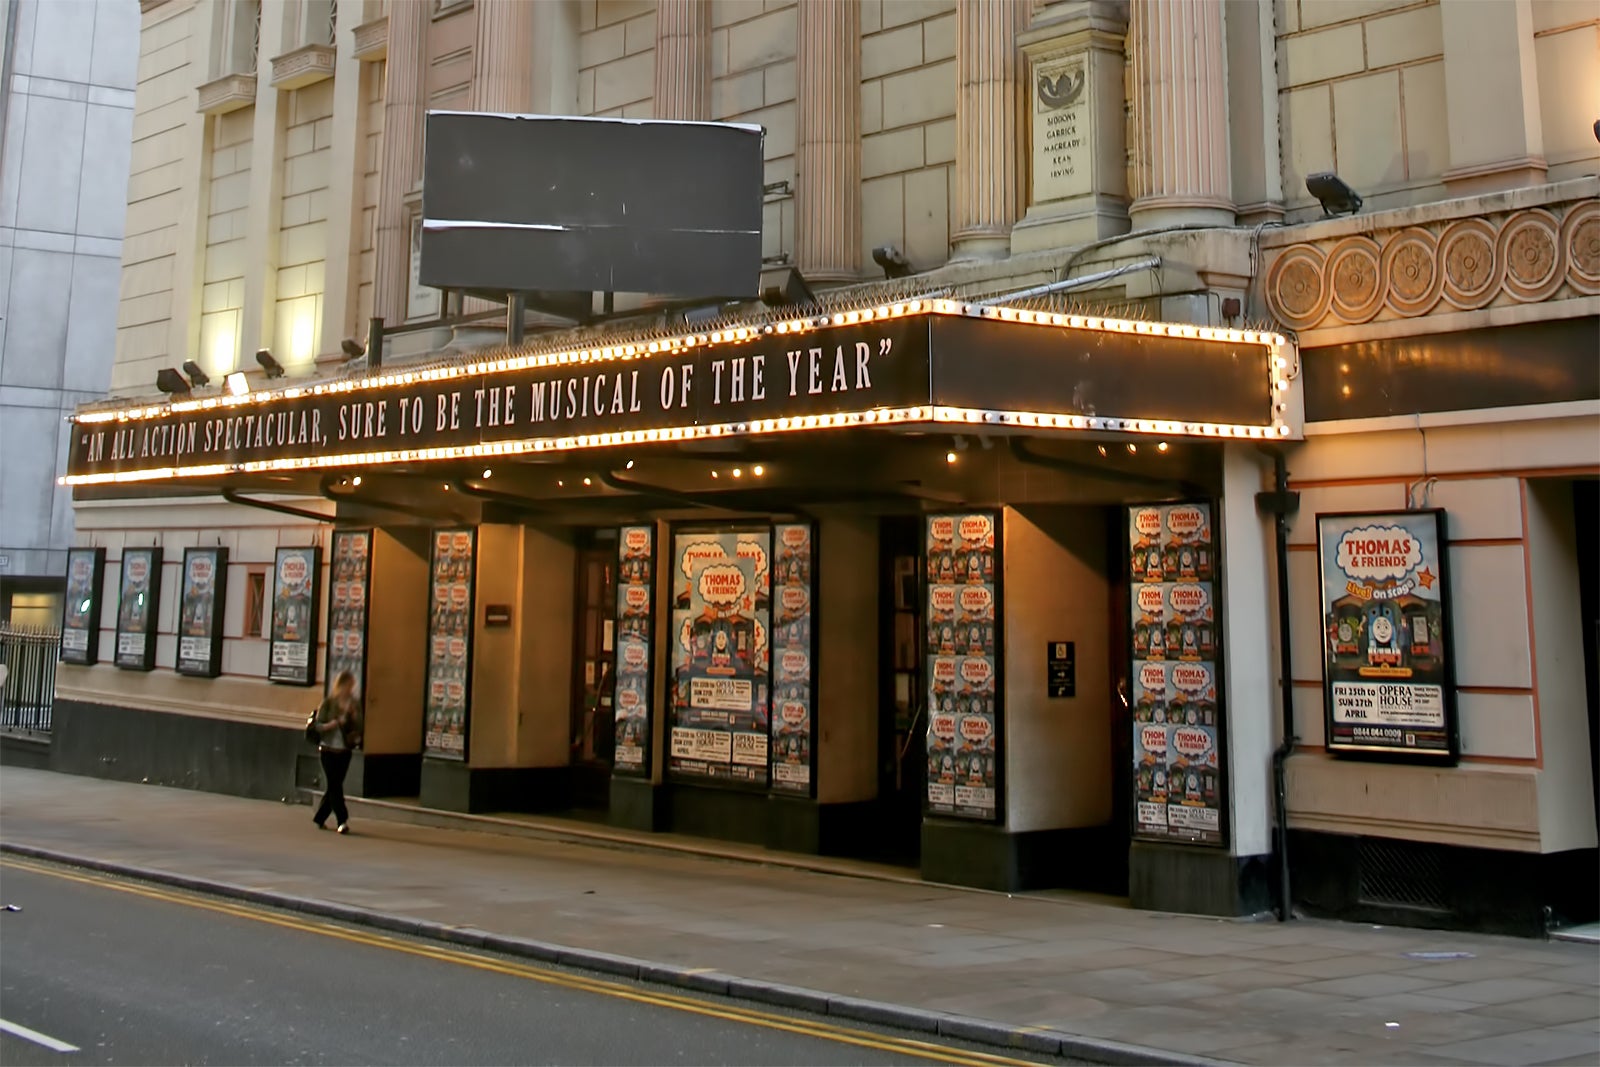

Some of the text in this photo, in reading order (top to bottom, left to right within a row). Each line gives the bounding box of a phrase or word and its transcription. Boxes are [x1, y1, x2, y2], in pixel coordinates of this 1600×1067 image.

[1046, 126, 1076, 139] GARRICK
[1044, 139, 1080, 152] MACREADY
[1053, 155, 1071, 164] KEAN
[1050, 166, 1074, 178] IRVING
[111, 428, 135, 460] ALL
[141, 421, 197, 458] ACTION
[204, 408, 328, 452] SPECTACULAR,
[338, 400, 387, 440] SURE
[399, 396, 424, 435] TO
[436, 392, 461, 432] BE
[474, 385, 516, 428] THE
[530, 370, 641, 423] MUSICAL
[660, 364, 694, 410] OF
[711, 355, 766, 404] THE
[1171, 513, 1199, 521] THOMAS
[1345, 539, 1411, 555] THOMAS
[1351, 556, 1407, 568] & FRIENDS
[704, 574, 740, 586] THOMAS
[712, 586, 737, 594] FRIENDS
[1346, 578, 1415, 599] Live! on stage
[1173, 590, 1202, 598] THOMAS
[936, 662, 955, 670] THOM
[1144, 669, 1163, 677] THOM
[1176, 669, 1205, 678] THOMAS
[1335, 687, 1376, 696] FRI 25th to
[1379, 685, 1412, 696] OPERA
[1338, 698, 1373, 707] SUN 27th
[1380, 696, 1412, 706] HOUSE
[1345, 709, 1367, 718] APRIL
[936, 718, 955, 726] THOM
[1144, 731, 1164, 739] THOM
[1177, 733, 1206, 743] THOMAS
